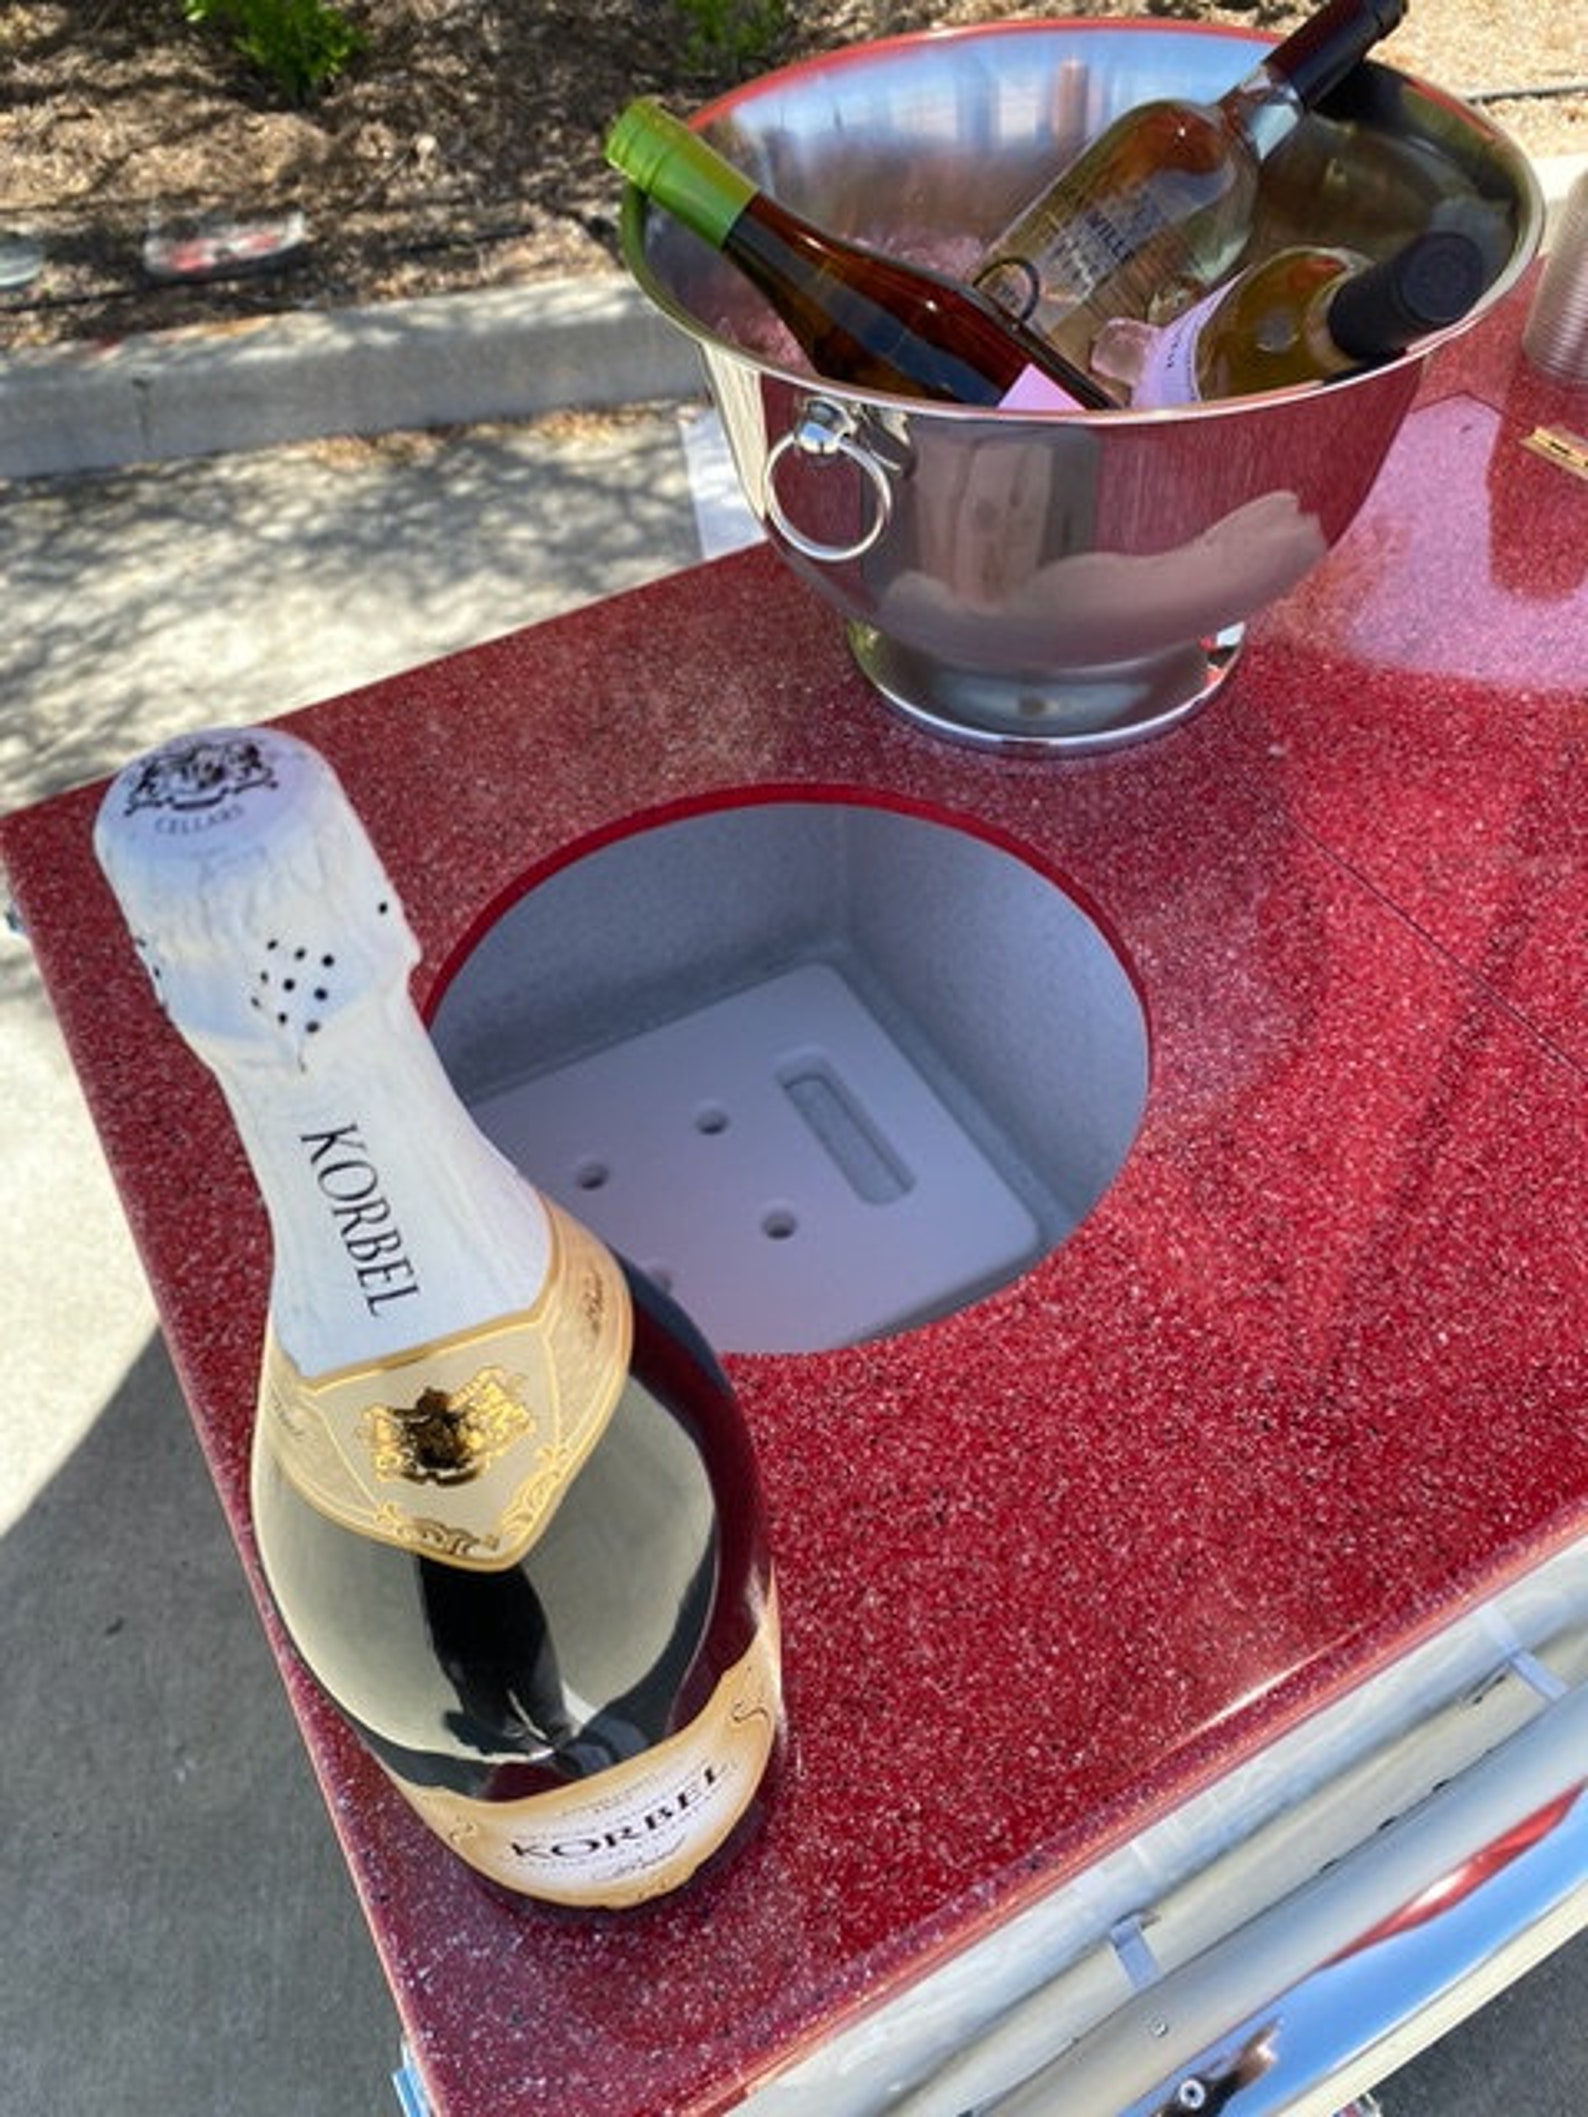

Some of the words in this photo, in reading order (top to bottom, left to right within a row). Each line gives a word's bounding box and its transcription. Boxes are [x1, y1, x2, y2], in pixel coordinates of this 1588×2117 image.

[154, 803, 245, 836] CELLARS
[300, 1123, 421, 1319] KORBEL
[510, 1764, 733, 1860] KORBEL
